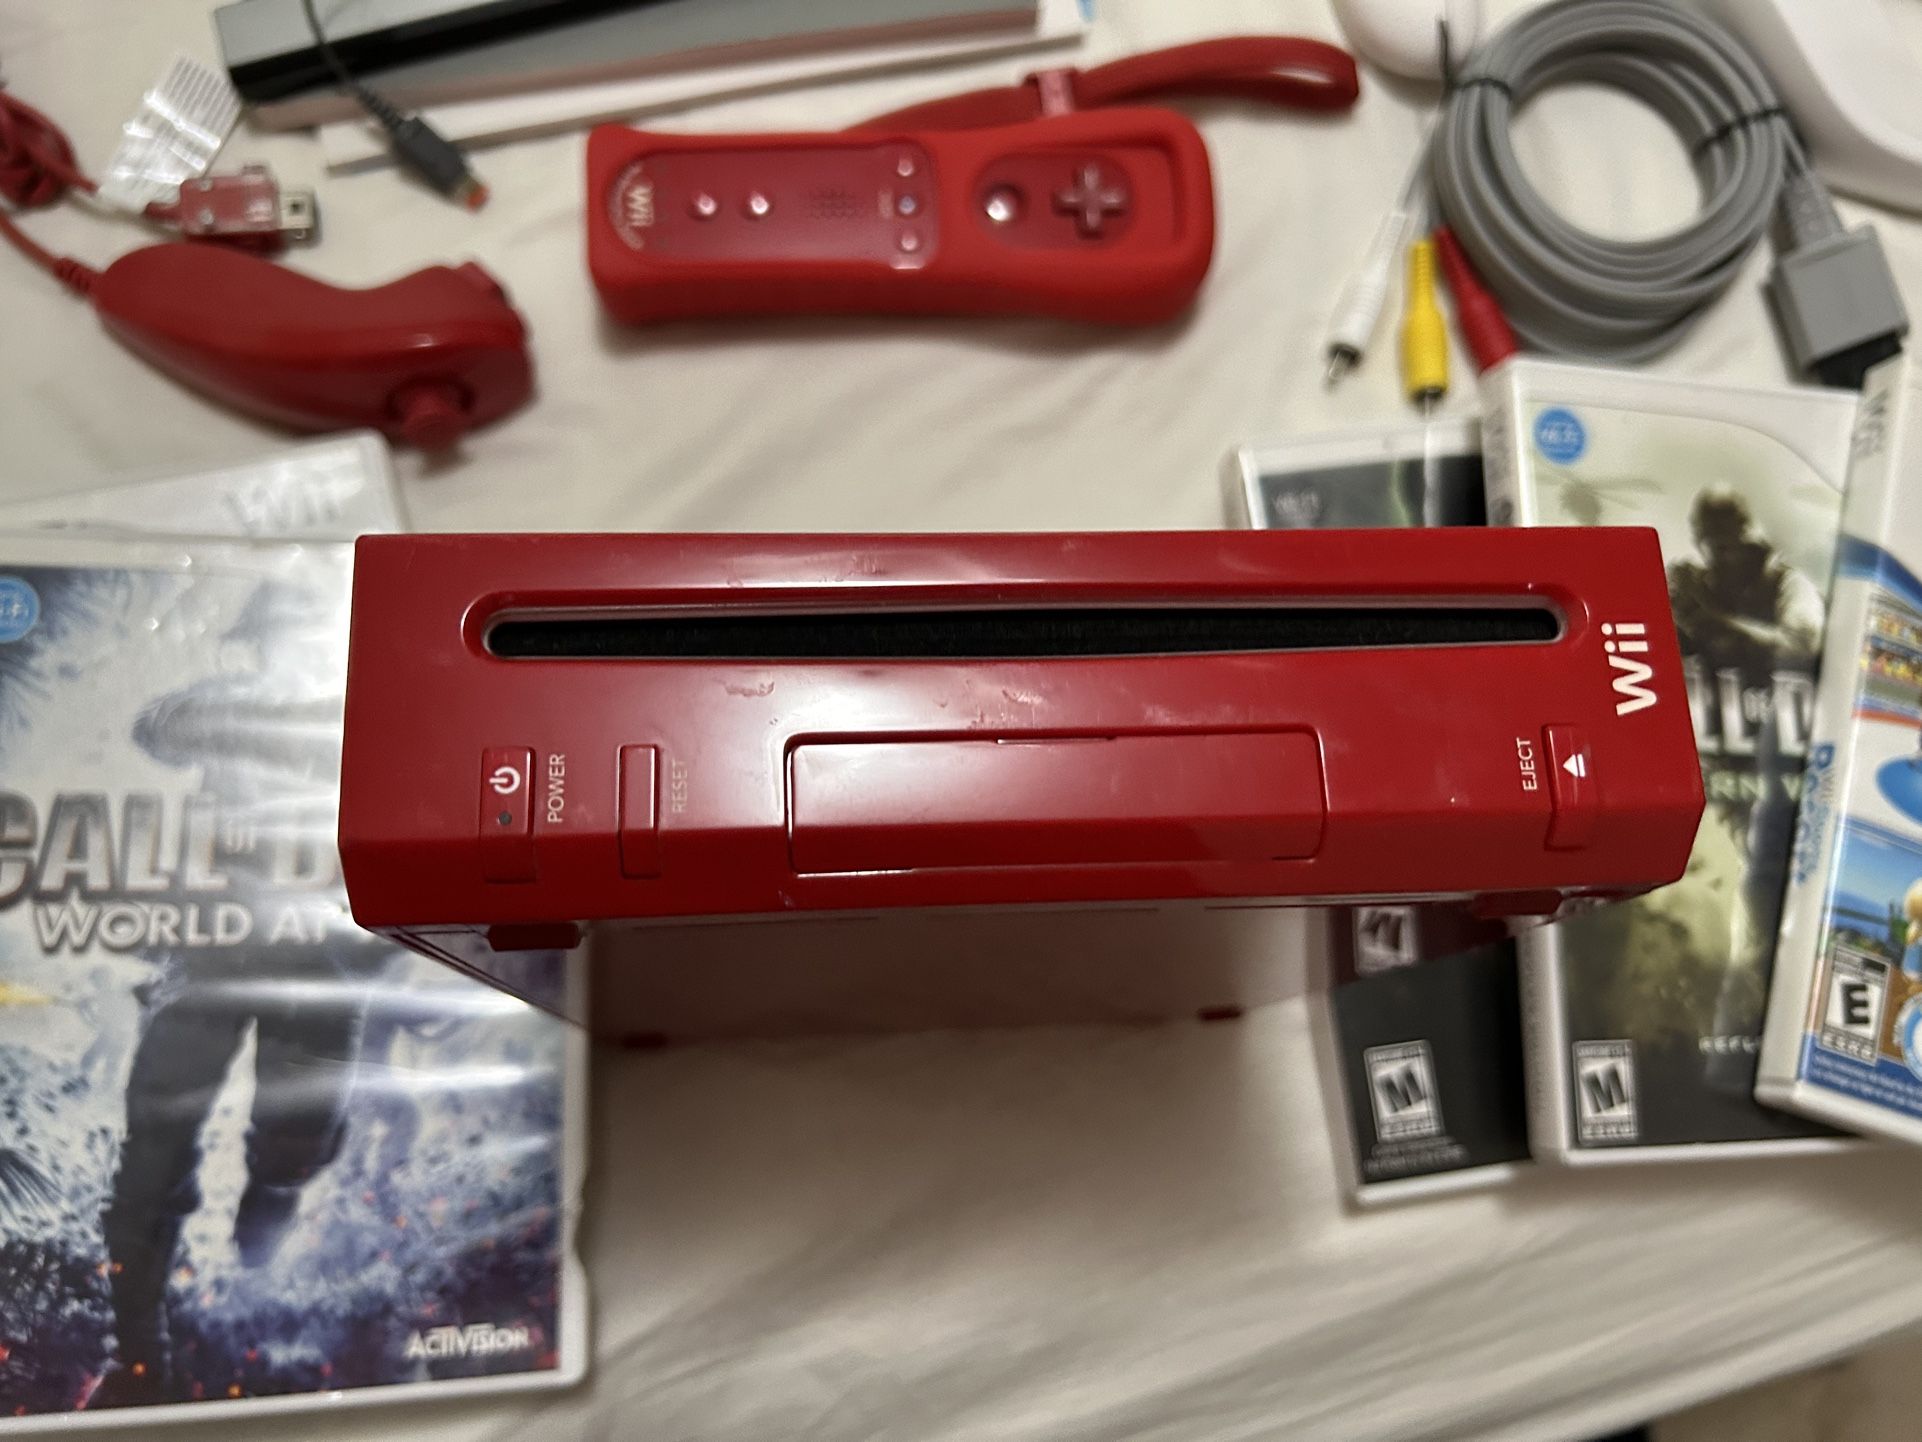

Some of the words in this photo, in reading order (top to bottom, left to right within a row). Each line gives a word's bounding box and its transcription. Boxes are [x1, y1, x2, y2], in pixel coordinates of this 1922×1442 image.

[1601, 623, 1657, 716] Wii
[547, 753, 566, 824] POWER
[671, 758, 688, 813] RESET
[1516, 736, 1538, 791] EJECT
[36, 902, 252, 950] WORLD
[1842, 983, 1871, 1025] E
[1375, 1063, 1427, 1113] M
[1581, 1061, 1627, 1114] M
[402, 1322, 529, 1359] ACTIVISION
